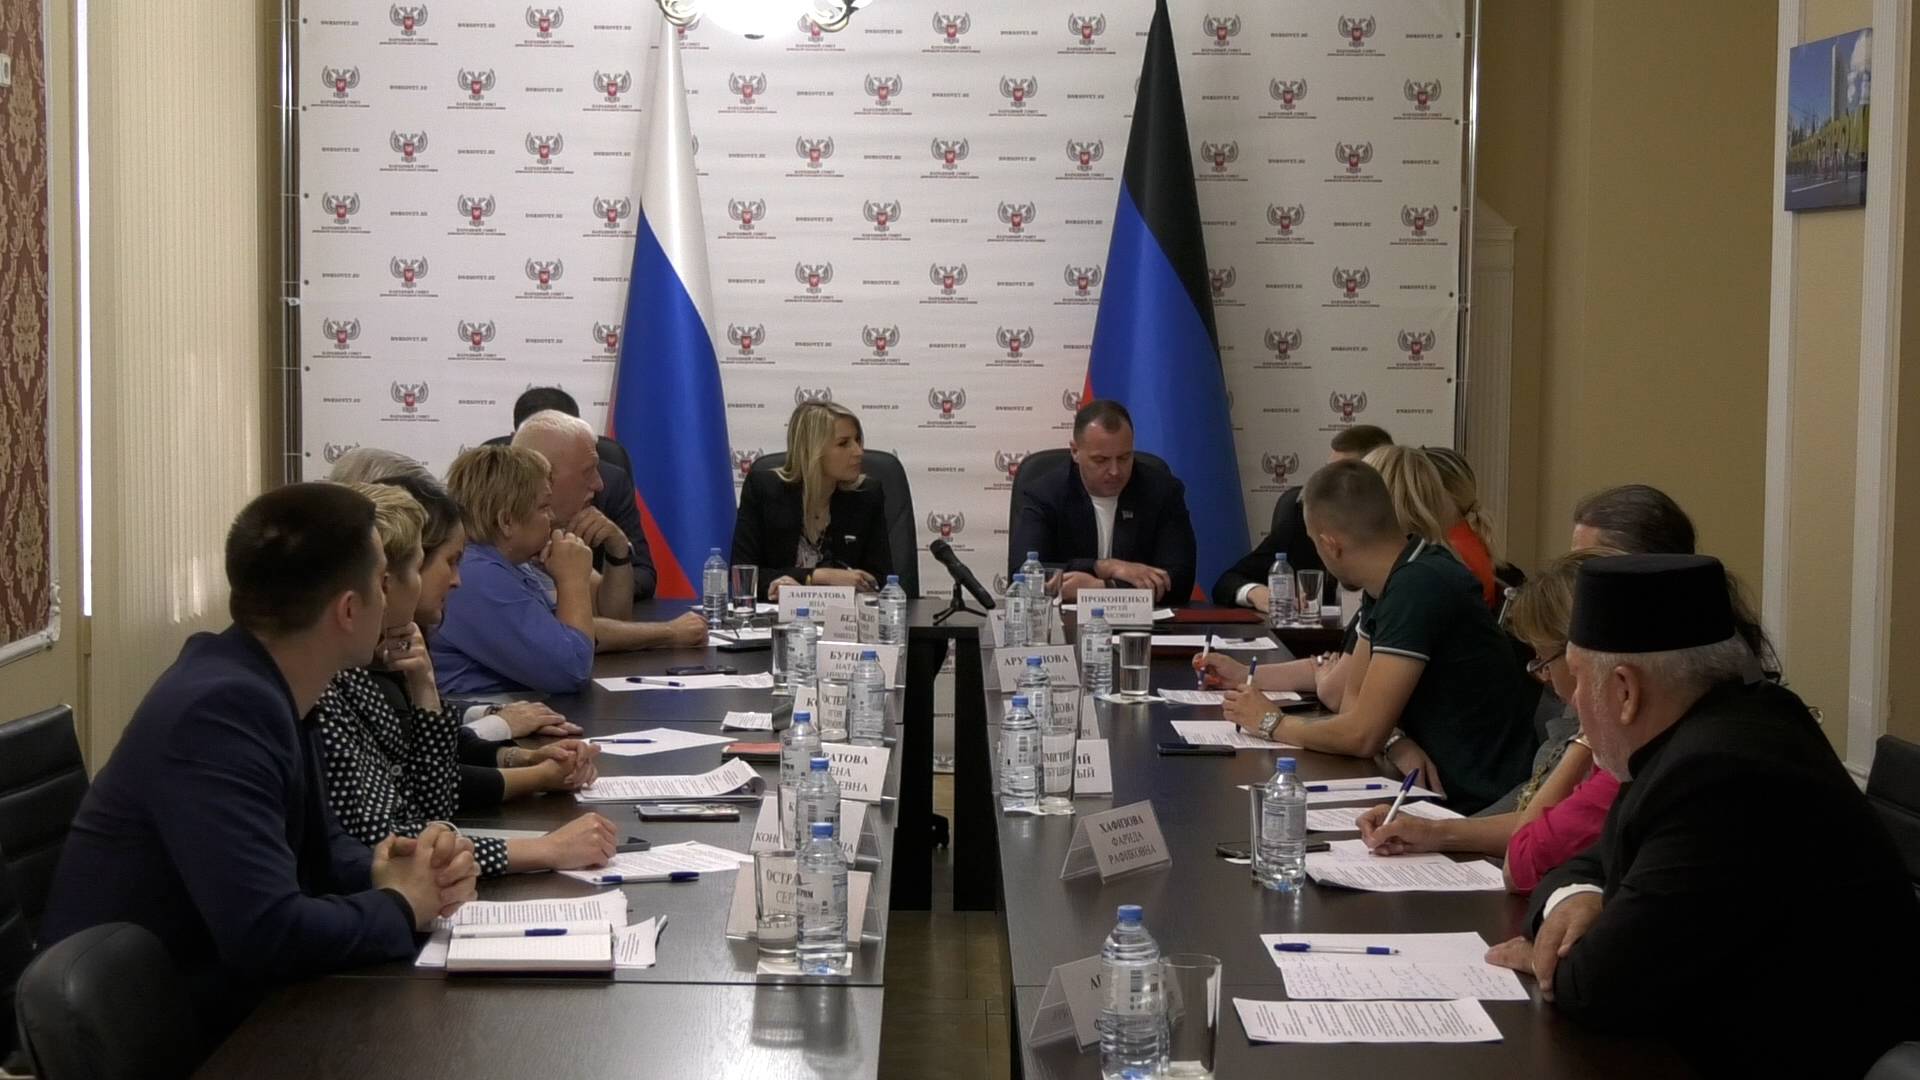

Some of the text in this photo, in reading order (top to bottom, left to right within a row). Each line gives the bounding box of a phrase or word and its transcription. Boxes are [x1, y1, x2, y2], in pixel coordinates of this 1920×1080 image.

[789, 591, 846, 599] ЛАНТРАТОВА
[1081, 595, 1149, 604] ПРОКОПЕНКО
[1004, 653, 1070, 667] АРУНОВА
[1111, 831, 1145, 847] ФАРИДА
[1108, 844, 1157, 865] РАФИКОВНА
